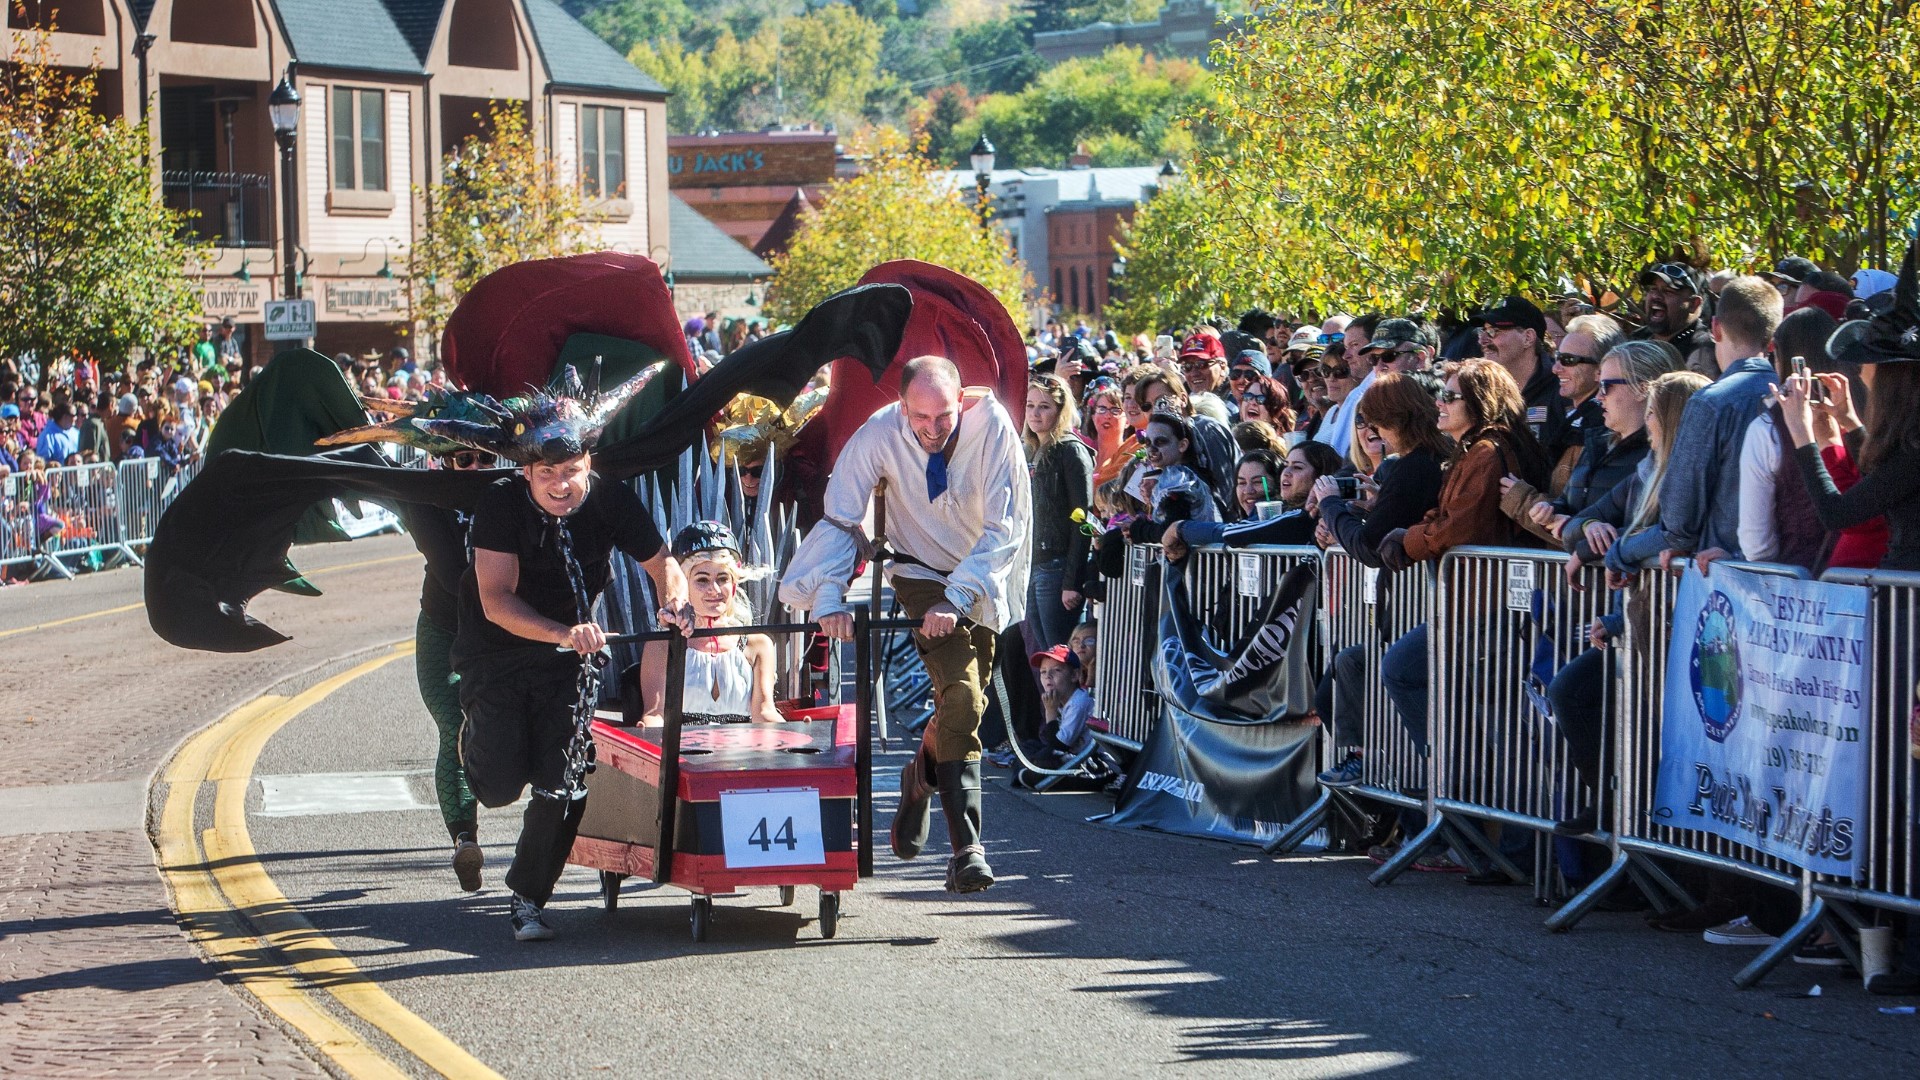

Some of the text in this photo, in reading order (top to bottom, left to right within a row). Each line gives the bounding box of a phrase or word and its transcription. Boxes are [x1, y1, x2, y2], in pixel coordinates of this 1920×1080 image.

[693, 149, 765, 174] JACK'S
[206, 291, 238, 309] OLIVE
[239, 291, 259, 308] TAP
[1794, 675, 1821, 697] Peak
[748, 816, 798, 852] 44
